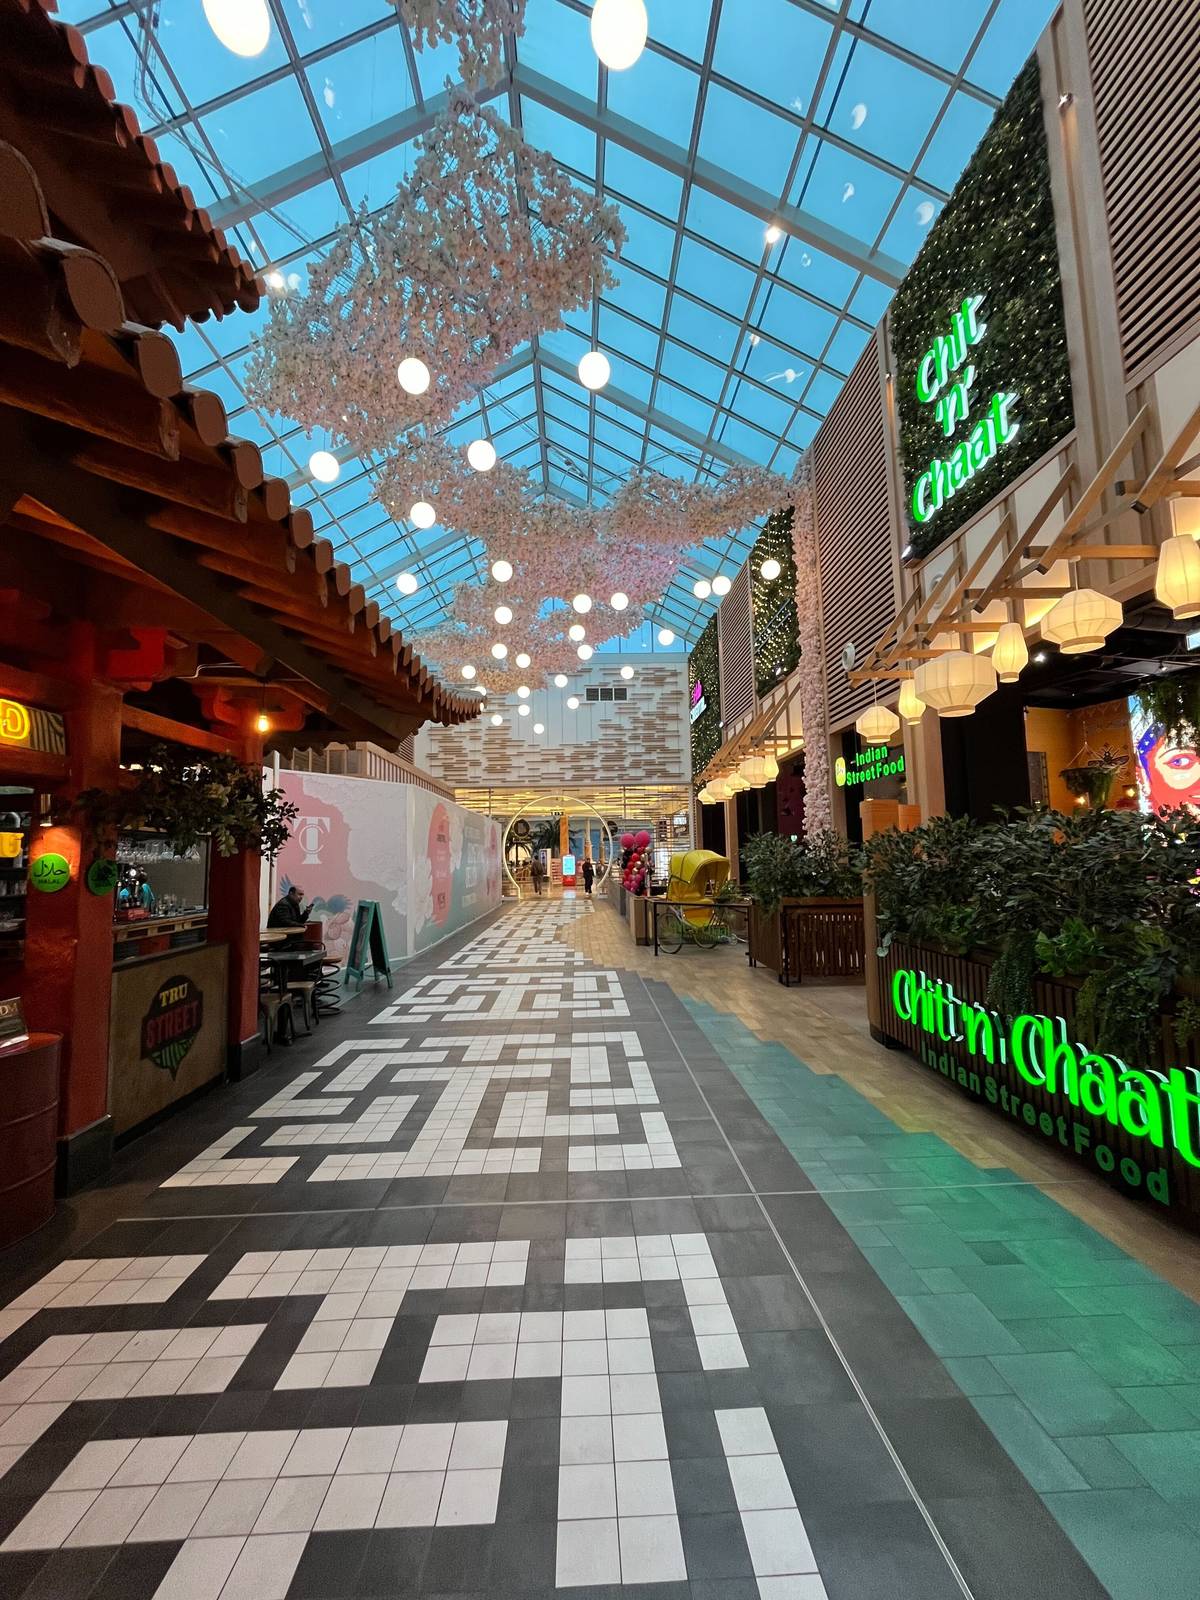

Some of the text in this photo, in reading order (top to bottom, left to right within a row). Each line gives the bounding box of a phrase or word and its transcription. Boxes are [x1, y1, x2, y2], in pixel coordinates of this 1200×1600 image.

[917, 295, 987, 402] Chit
[913, 392, 1020, 522] Chaat
[855, 745, 888, 767] Indian
[146, 1000, 200, 1050] STREET
[160, 982, 188, 1008] TRU
[893, 969, 952, 1041] Chit
[1012, 1013, 1200, 1169] Chaat
[920, 1040, 981, 1095] Indian
[1073, 1121, 1170, 1207] Food
